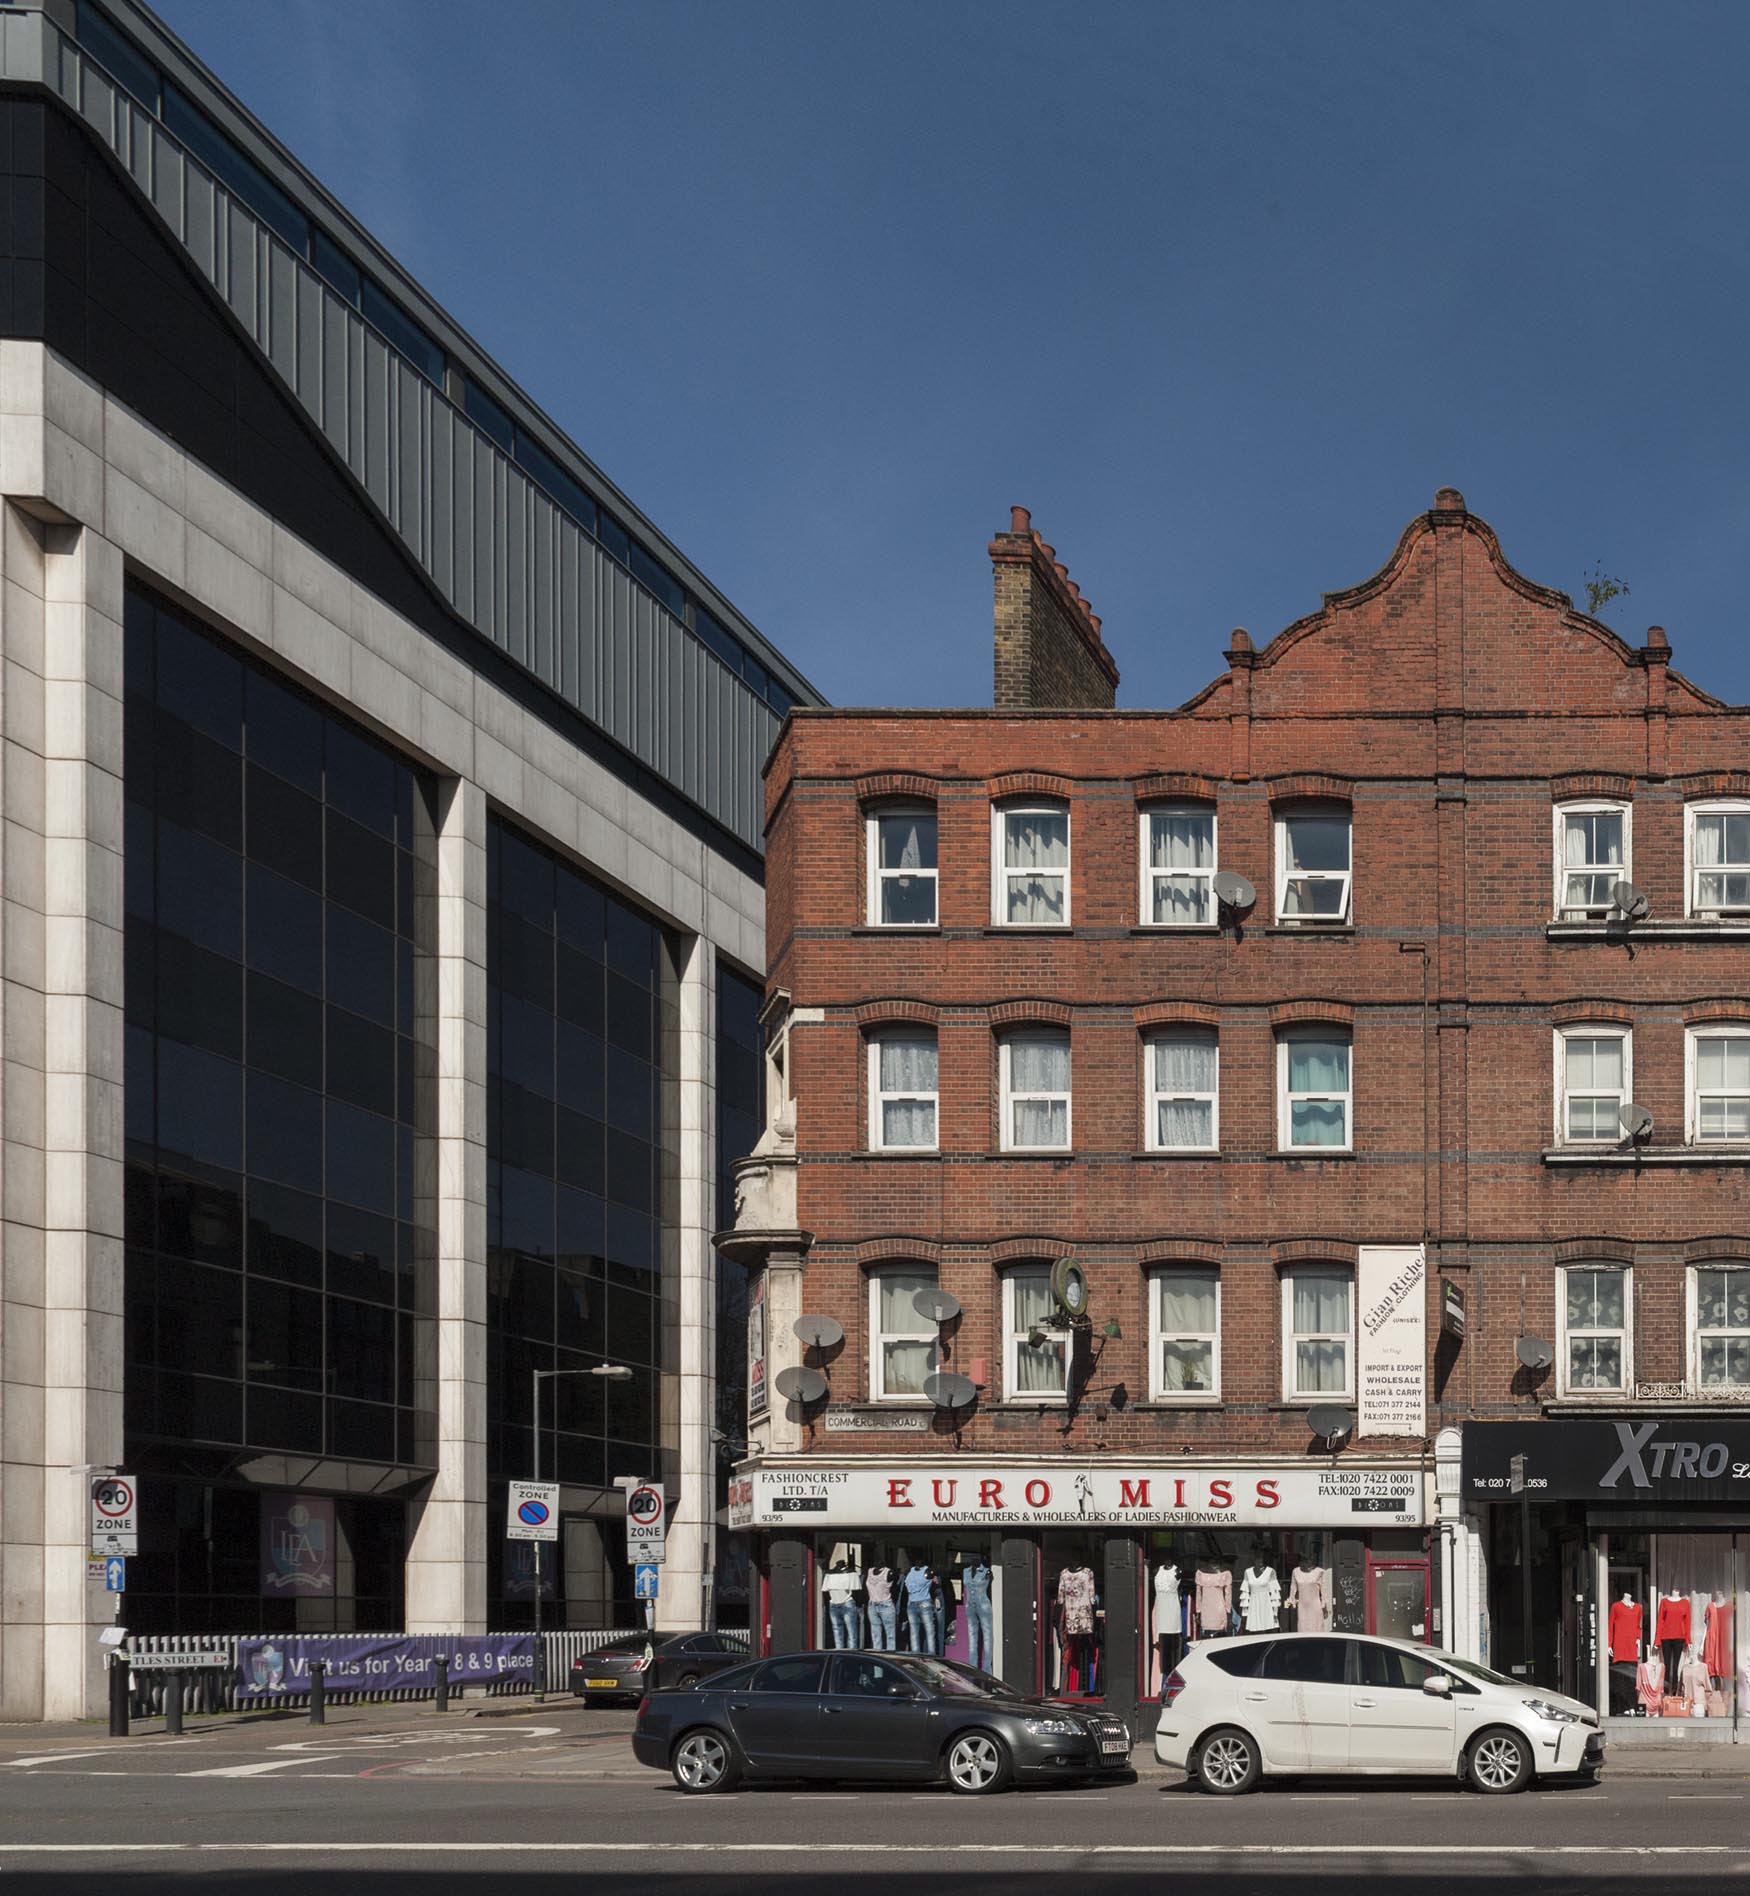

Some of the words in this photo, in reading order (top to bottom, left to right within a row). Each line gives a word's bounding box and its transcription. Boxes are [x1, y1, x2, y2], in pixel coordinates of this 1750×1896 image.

[1369, 1307, 1396, 1337] FASHION
[1396, 1272, 1424, 1304] CLOTHING
[1363, 1296, 1394, 1330] Gian
[1366, 1376, 1421, 1384] WHOLESALE
[828, 1418, 889, 1427] COMMERCIAL
[892, 1418, 917, 1427] ROAD
[762, 1473, 849, 1483] FASHIONCREST
[1363, 1474, 1388, 1484] 7422
[1390, 1474, 1414, 1484] 0001
[512, 1482, 557, 1492] Controlled
[1473, 1479, 1487, 1488] Tel:
[1488, 1479, 1504, 1488] 020
[1527, 1479, 1548, 1488] 0536
[518, 1490, 550, 1500] ZONE
[782, 1486, 807, 1496] LTD.
[809, 1486, 829, 1496] T/A
[886, 1478, 1053, 1509] EURO
[1118, 1478, 1281, 1509] MISS
[1363, 1486, 1388, 1496] 7422
[1390, 1486, 1415, 1496] 0009
[101, 1490, 127, 1505] 20
[634, 1498, 657, 1514] 20
[762, 1514, 784, 1522] 93/95
[931, 1512, 1020, 1522] MANUFACTURERS
[1022, 1512, 1031, 1522] &
[1032, 1512, 1106, 1522] WHOLESALERS
[1108, 1512, 1123, 1522] OF
[1125, 1512, 1161, 1522] LADIES
[1163, 1512, 1238, 1522] FASHIONWEAR
[1395, 1514, 1416, 1523] 93/95
[96, 1519, 132, 1529] ZONE
[630, 1527, 661, 1537] ZONE
[134, 1656, 162, 1665] TLES
[164, 1656, 207, 1665] STREET
[289, 1657, 333, 1677] Viit
[339, 1659, 359, 1676] us
[364, 1656, 390, 1673] for
[394, 1654, 431, 1673] Year
[454, 1652, 463, 1671] 8
[468, 1652, 481, 1670] &
[484, 1652, 493, 1669] 9
[498, 1653, 533, 1672] place
